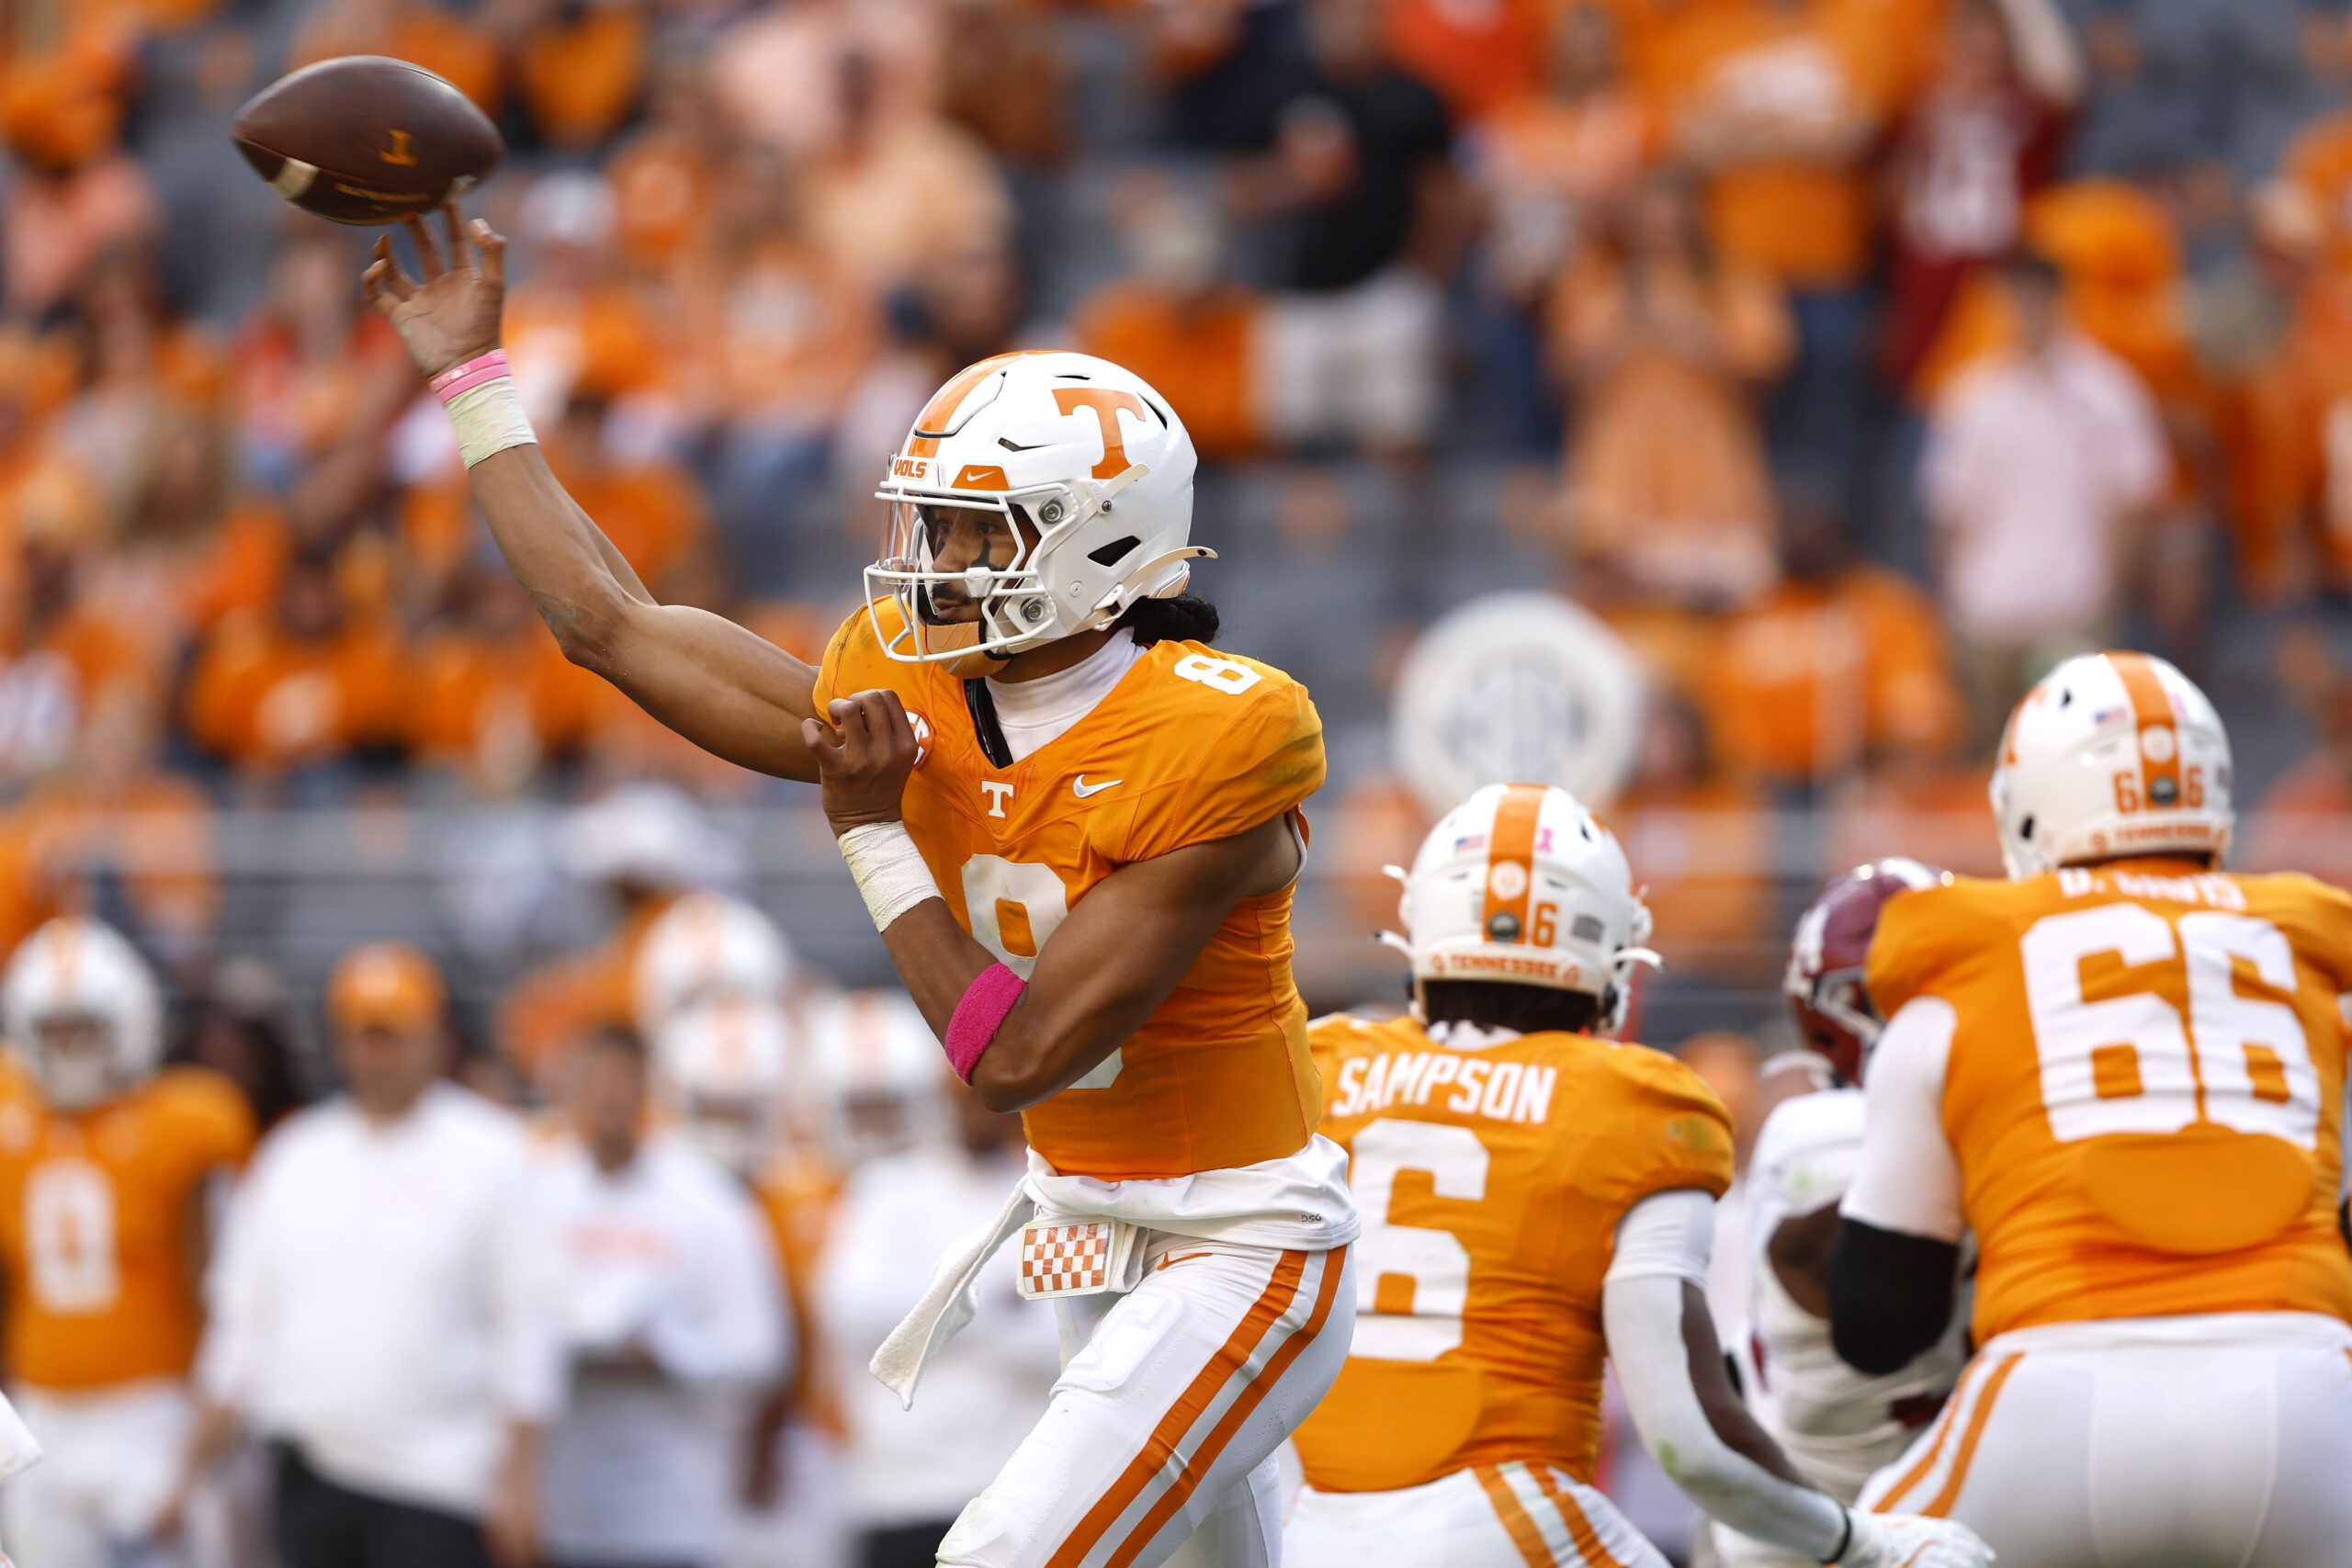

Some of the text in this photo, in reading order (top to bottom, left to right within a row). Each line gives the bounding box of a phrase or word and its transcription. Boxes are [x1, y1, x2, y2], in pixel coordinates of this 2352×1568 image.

[1051, 387, 1147, 479] T
[894, 458, 927, 479] VOLS
[1174, 654, 1263, 695] 8
[980, 780, 1014, 818] T
[1532, 901, 1558, 950] 6
[2020, 902, 2322, 1152] 66
[1330, 1052, 1557, 1124] SAMPSON
[1348, 1117, 1490, 1361] 6
